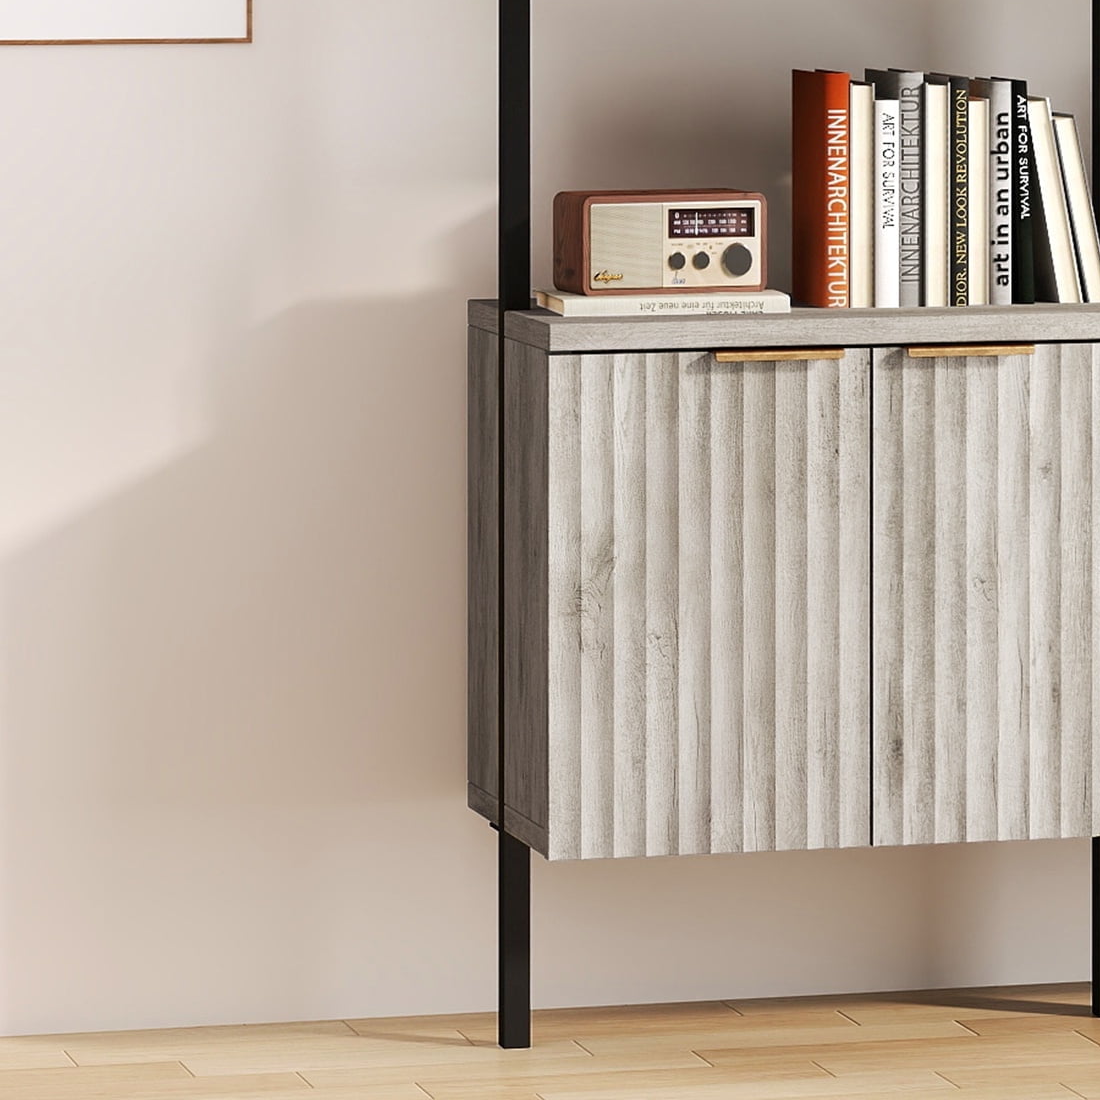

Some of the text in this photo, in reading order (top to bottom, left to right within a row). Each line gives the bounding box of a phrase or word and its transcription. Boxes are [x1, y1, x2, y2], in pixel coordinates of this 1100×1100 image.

[827, 109, 846, 307] INNENARCHITEKTUR
[882, 113, 895, 229] ART FOR SURVIVAL
[901, 86, 919, 282] INNENARCHITEKTUR
[956, 90, 967, 306] DIOR. NEW LOOK REVOLUTION
[990, 112, 1009, 286] art in an urban
[1016, 95, 1031, 219] ART FOR SURVIVAL
[640, 302, 764, 311] Architektur für eine neue Zeit
